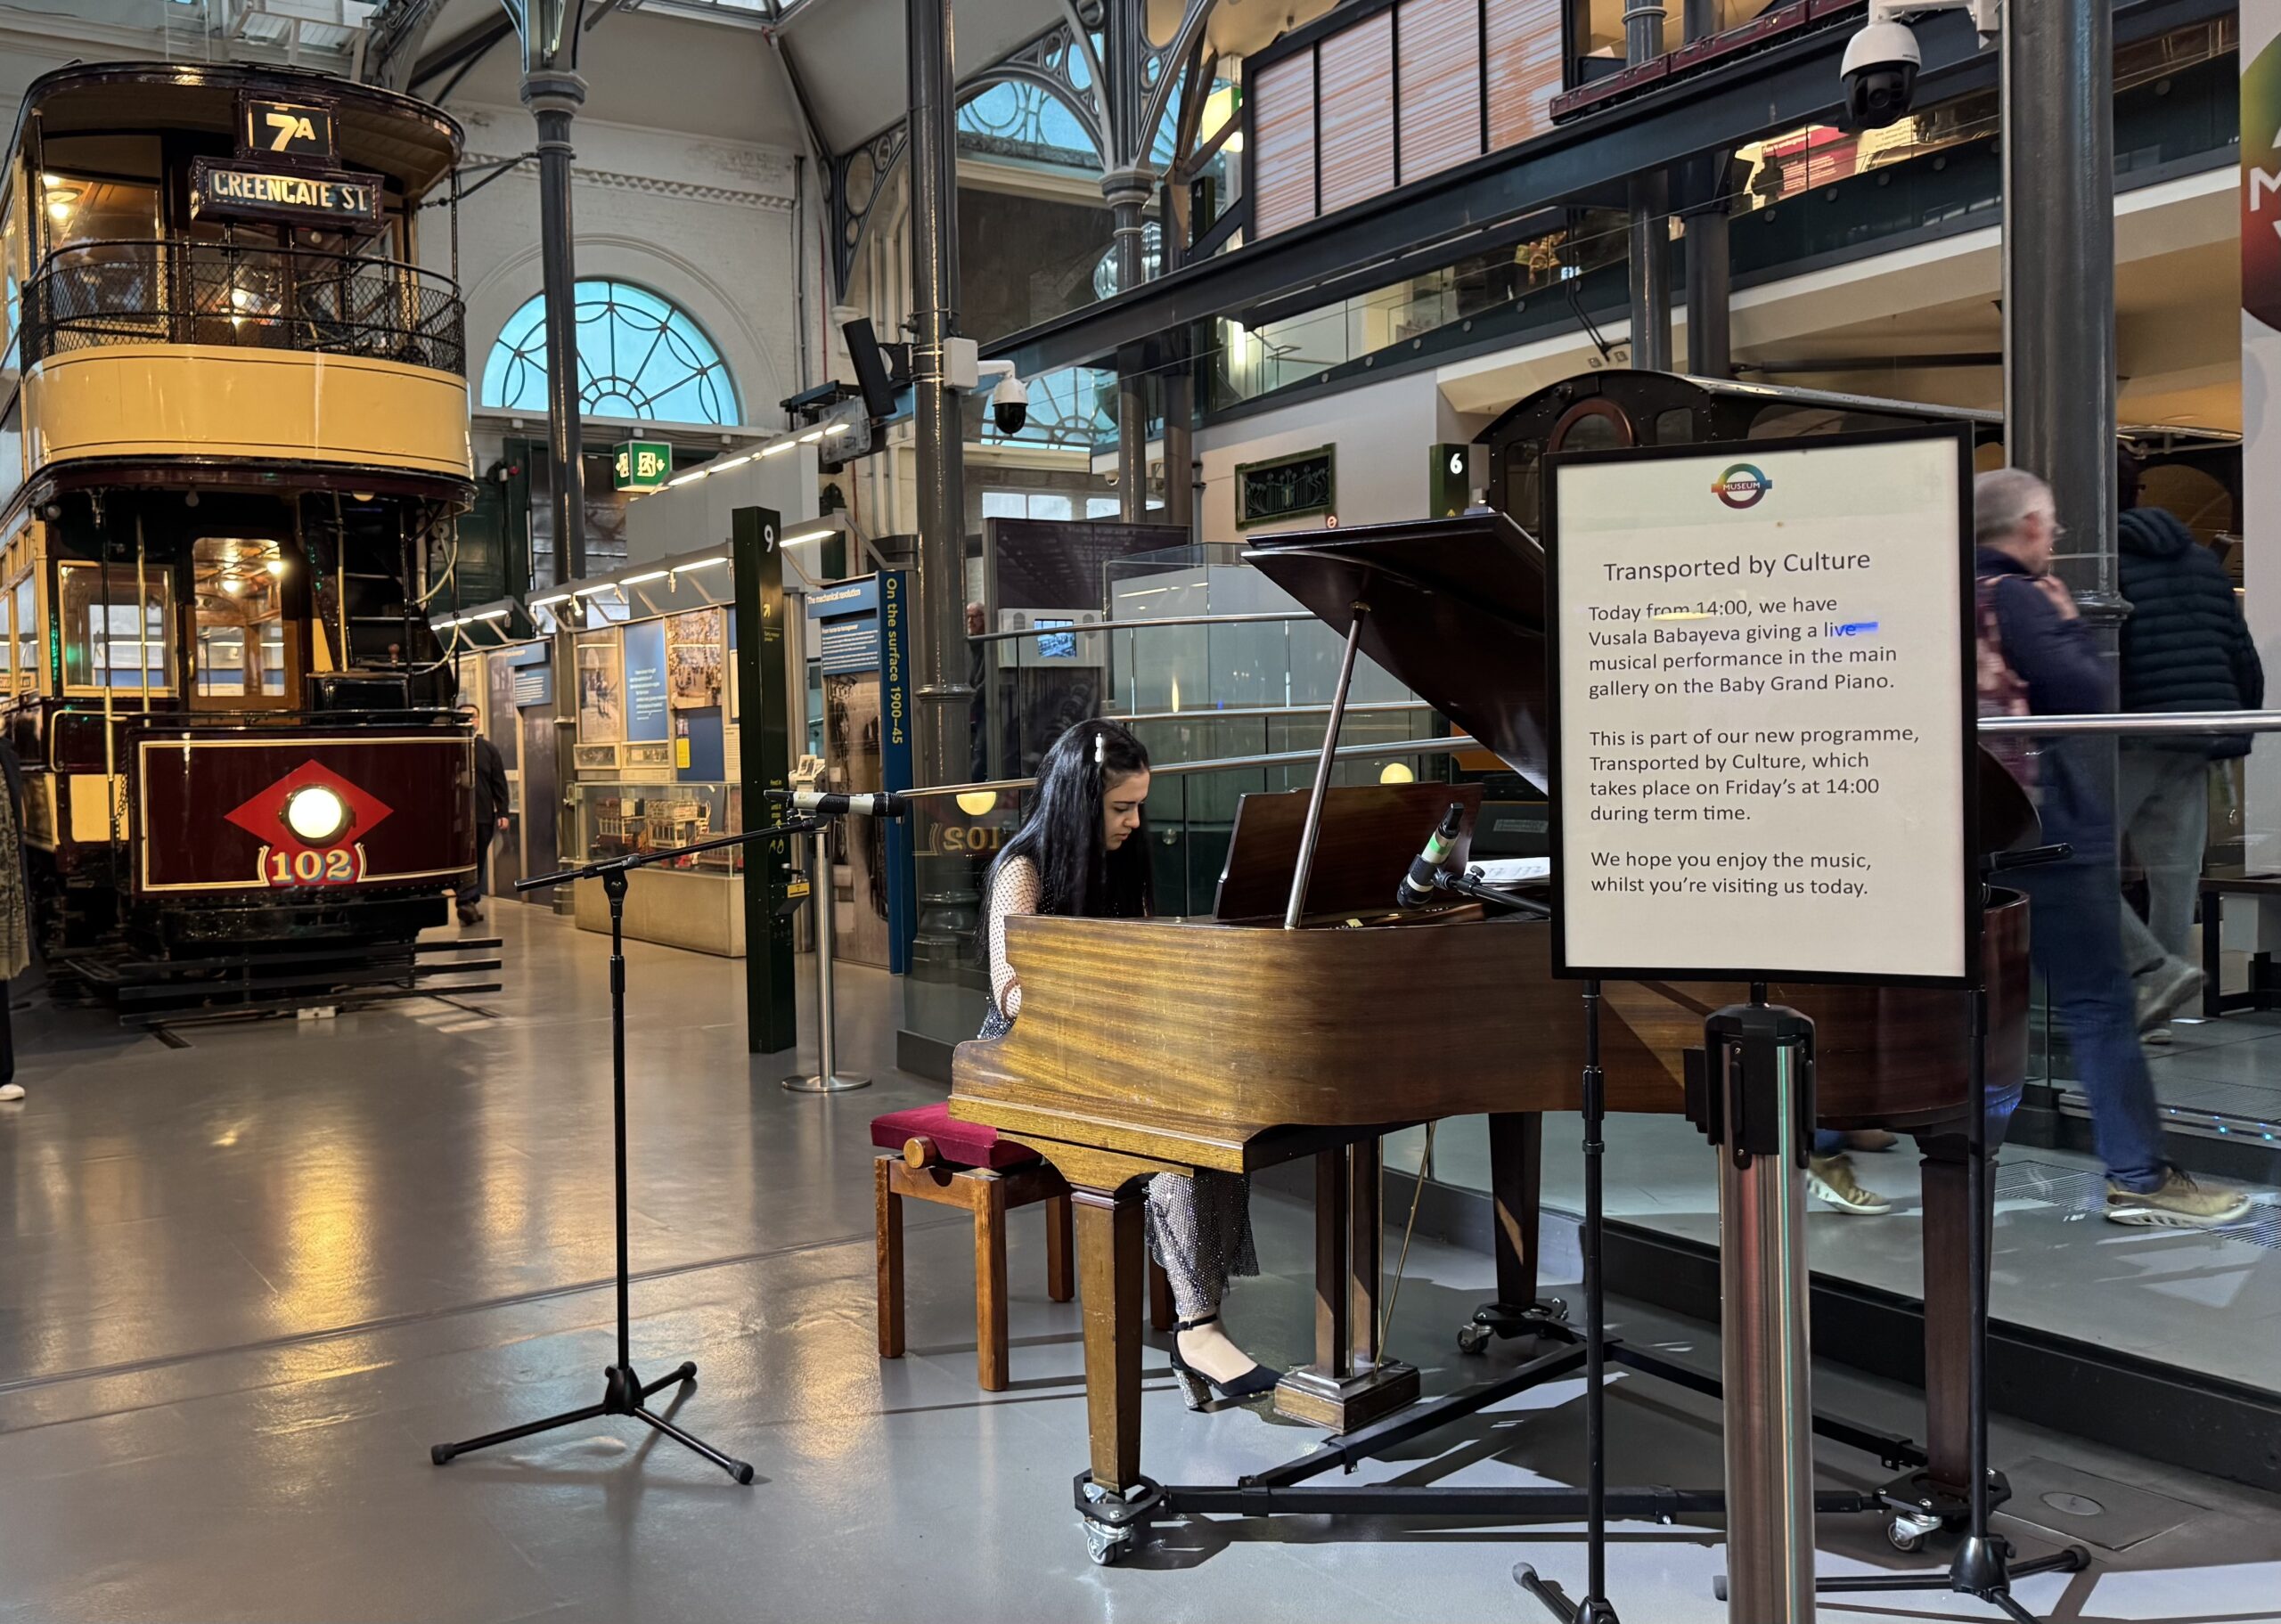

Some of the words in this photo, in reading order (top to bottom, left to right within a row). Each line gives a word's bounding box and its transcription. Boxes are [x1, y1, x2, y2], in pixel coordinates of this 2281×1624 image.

[266, 112, 316, 152] 7A
[1450, 453, 1463, 475] 6
[1722, 481, 1761, 492] MUSEUM
[764, 524, 774, 553] 9
[1603, 555, 1740, 583] Transported
[1749, 554, 1777, 578] by
[1783, 551, 1870, 572] Culture
[886, 577, 898, 600] On
[887, 603, 899, 627] the
[1588, 604, 1641, 624] Today
[1696, 600, 1753, 617] 14:00,
[1759, 601, 1786, 614] we
[1793, 596, 1837, 613] have
[1588, 629, 1647, 647] Vusala
[1654, 627, 1740, 646] Babayeva
[1745, 624, 1802, 644] giving
[1807, 625, 1818, 638] a
[1823, 621, 1857, 639] live
[888, 631, 900, 682] surface
[1590, 653, 1656, 672] musical
[1663, 651, 1783, 673] performance
[1788, 649, 1805, 665] in
[1811, 648, 1844, 664] the
[1849, 646, 1897, 663] main
[1589, 680, 1650, 700] gallery
[1654, 682, 1678, 695] on
[1682, 677, 1714, 694] the
[1720, 676, 1765, 696] Baby
[1770, 673, 1827, 691] Grand
[1835, 673, 1894, 690] Piano.
[1589, 730, 1626, 747] This
[1631, 730, 1645, 746] is
[1650, 730, 1688, 749] part
[1693, 728, 1713, 745] of
[1717, 731, 1750, 744] our
[1754, 730, 1795, 744] new
[1801, 729, 1919, 747] programme,
[1589, 754, 1699, 774] Transported
[1705, 754, 1727, 773] by
[1732, 753, 1806, 771] Culture,
[1811, 751, 1869, 769] which
[1590, 780, 1637, 796] takes
[1642, 779, 1690, 799] place
[1696, 783, 1720, 796] on
[1726, 778, 1796, 798] Friday’s
[1802, 779, 1820, 795] at
[1827, 778, 1879, 794] 14:00
[1590, 804, 1648, 824] during
[1653, 806, 1697, 820] term
[1703, 804, 1751, 820] time.
[272, 849, 355, 883] 102
[1590, 852, 1621, 867] We
[1626, 851, 1672, 870] hope
[1677, 855, 1711, 870] you
[1716, 852, 1768, 871] enjoy
[1772, 851, 1804, 868] the
[1811, 852, 1871, 871] music,
[1590, 876, 1645, 893] whilst
[1648, 877, 1707, 896] you’re
[1712, 877, 1778, 897] visiting
[1784, 882, 1804, 894] us
[1810, 877, 1868, 899] today.
